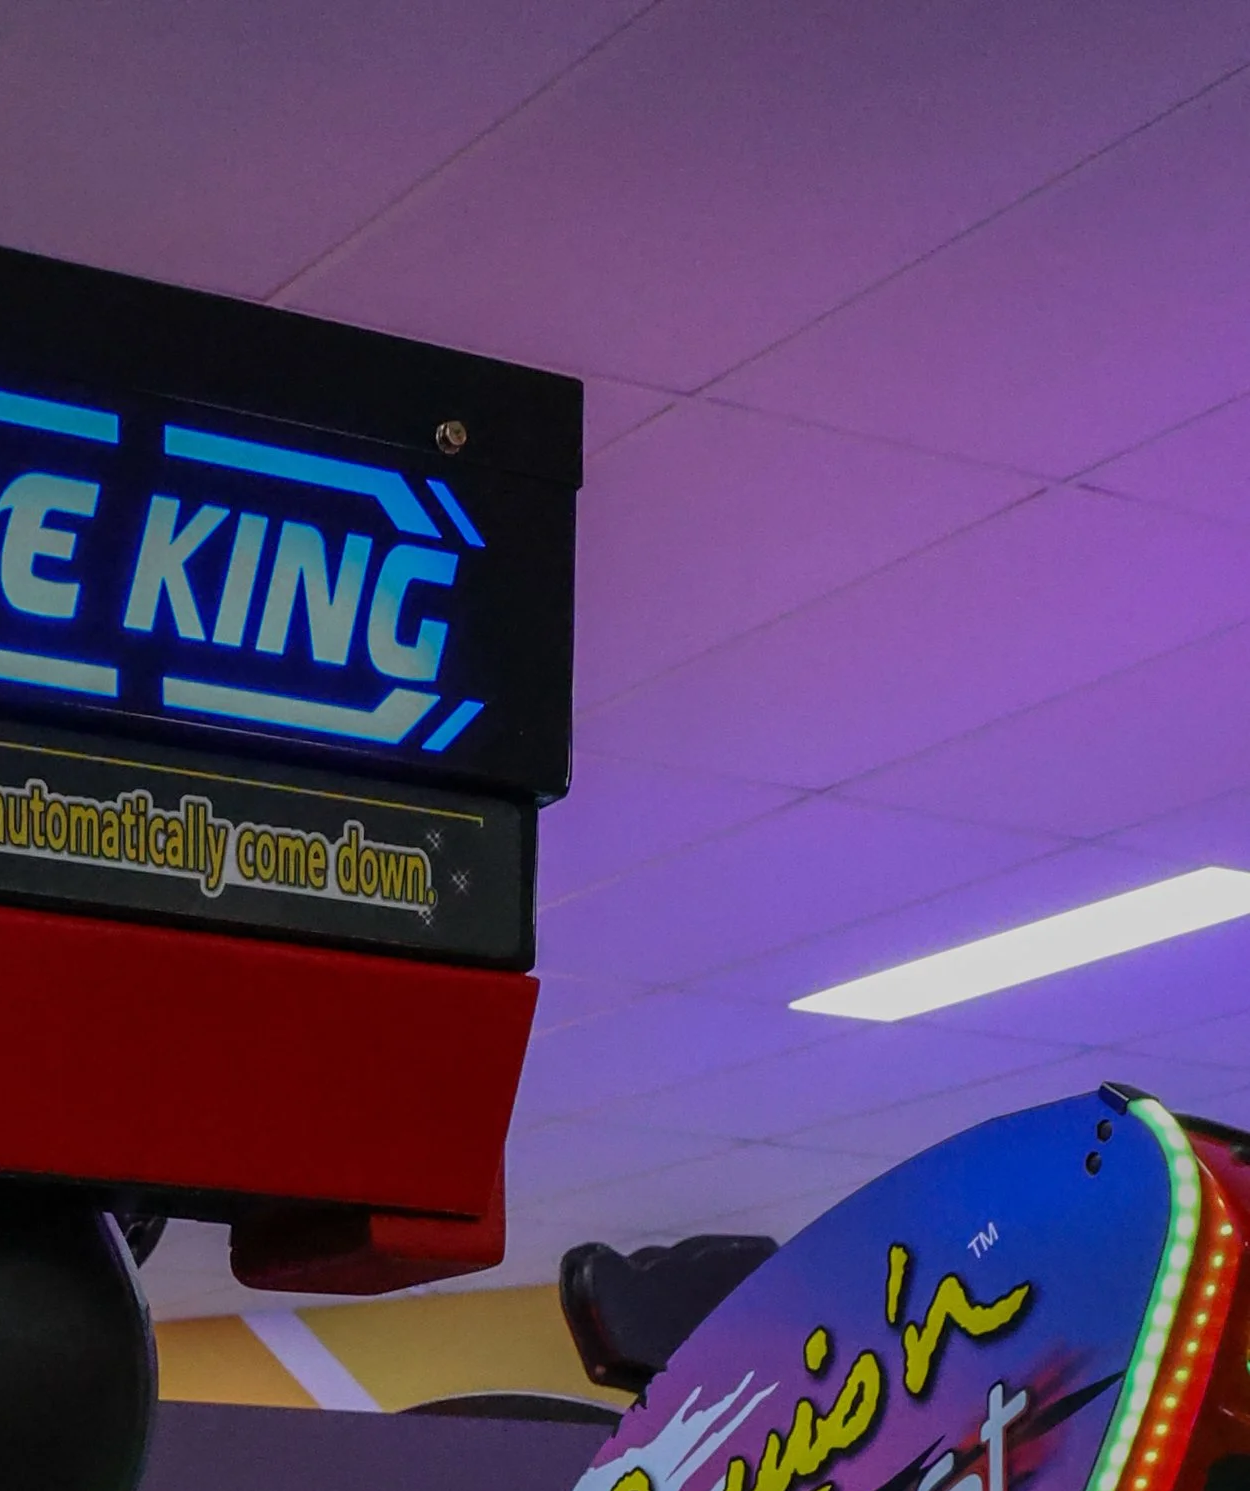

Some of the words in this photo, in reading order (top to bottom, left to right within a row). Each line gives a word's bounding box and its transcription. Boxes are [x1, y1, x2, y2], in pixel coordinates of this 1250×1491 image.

[124, 495, 459, 683] KING
[237, 828, 327, 891] come
[337, 825, 437, 907] down.
